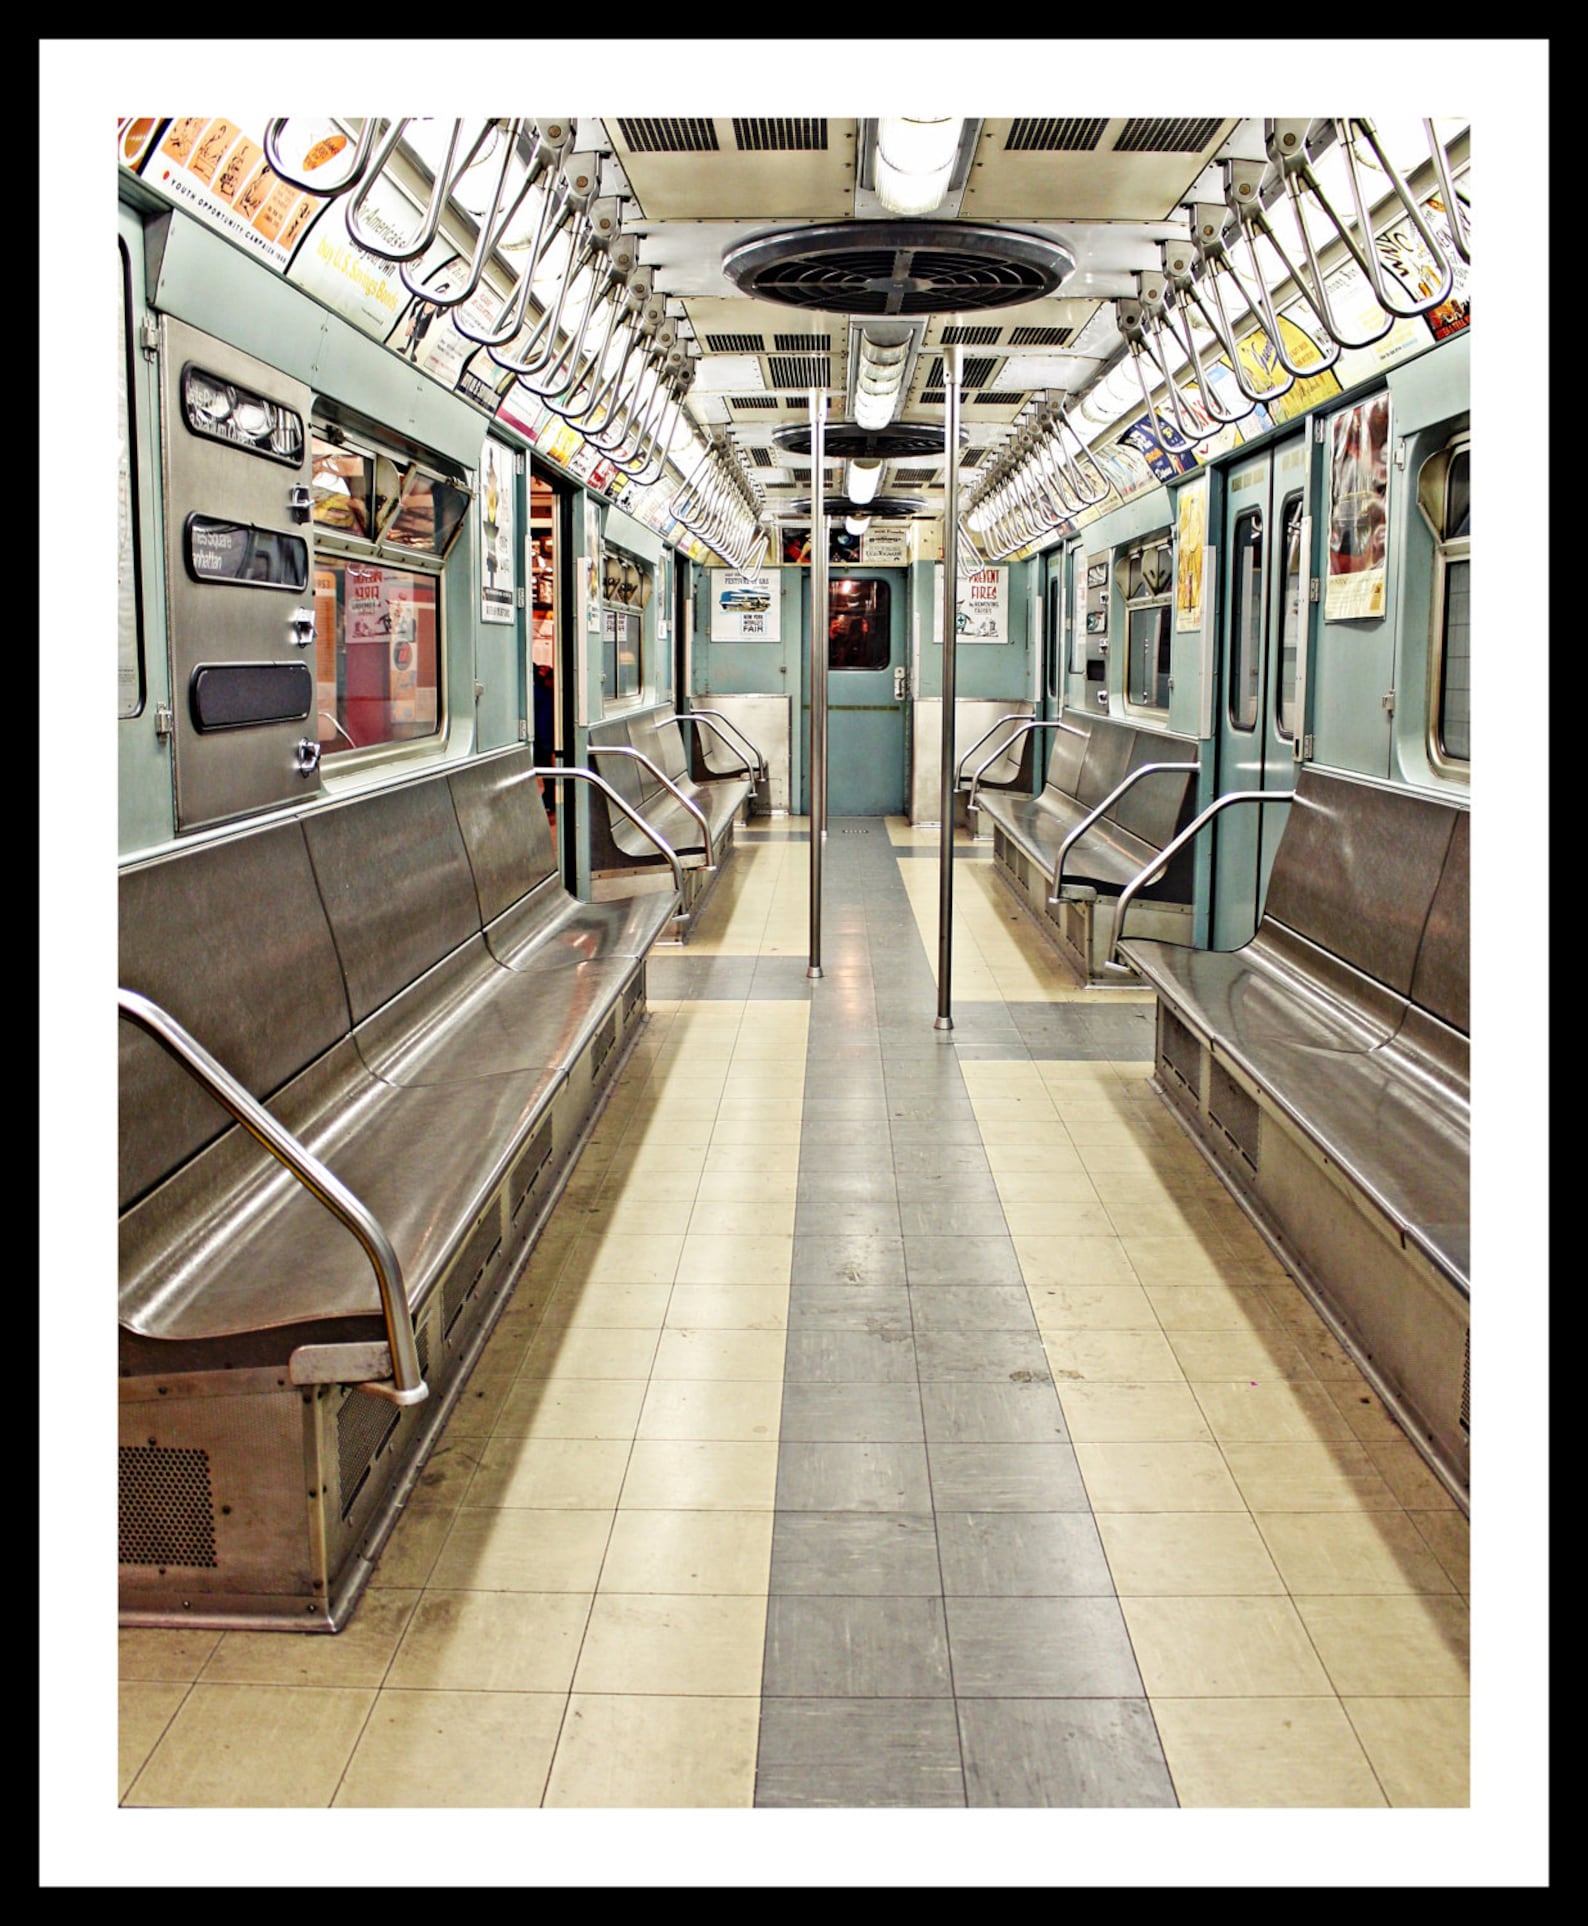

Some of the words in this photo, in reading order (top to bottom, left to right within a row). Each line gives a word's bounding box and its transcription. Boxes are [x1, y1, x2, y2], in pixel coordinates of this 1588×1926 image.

[170, 178, 196, 200] YOUTH
[198, 199, 244, 233] OPPORTUNITY
[971, 586, 997, 600] FIRES
